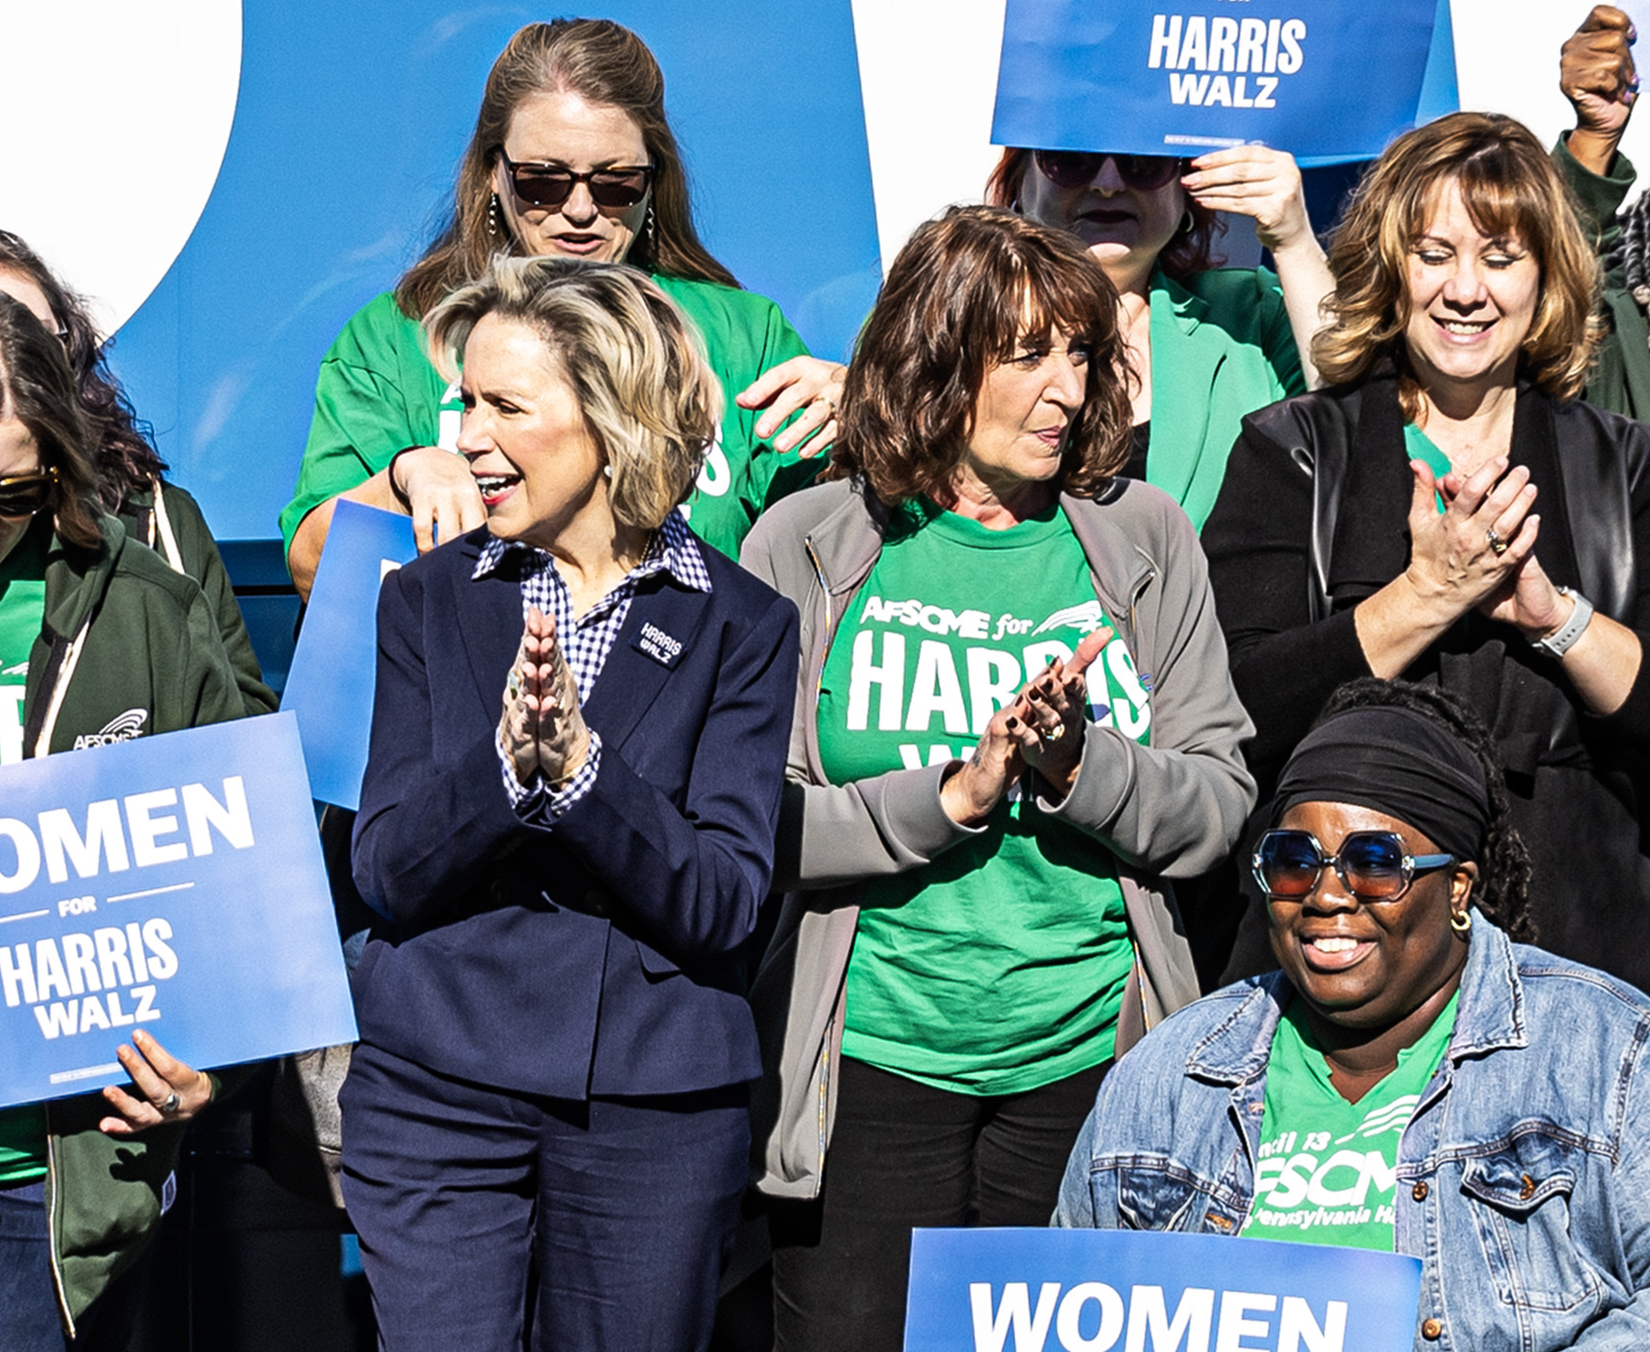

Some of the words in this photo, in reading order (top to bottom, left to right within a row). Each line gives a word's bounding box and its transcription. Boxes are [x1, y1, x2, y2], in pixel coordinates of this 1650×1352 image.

[1148, 14, 1307, 74] HARRIS
[1169, 72, 1279, 109] WALZ
[860, 595, 991, 640] AFSCME
[991, 613, 1034, 641] for
[640, 621, 683, 656] HARRIS
[640, 637, 672, 664] WALZ
[58, 894, 97, 918] FOR
[33, 984, 161, 1041] WALZ
[1302, 1131, 1332, 1152] 13
